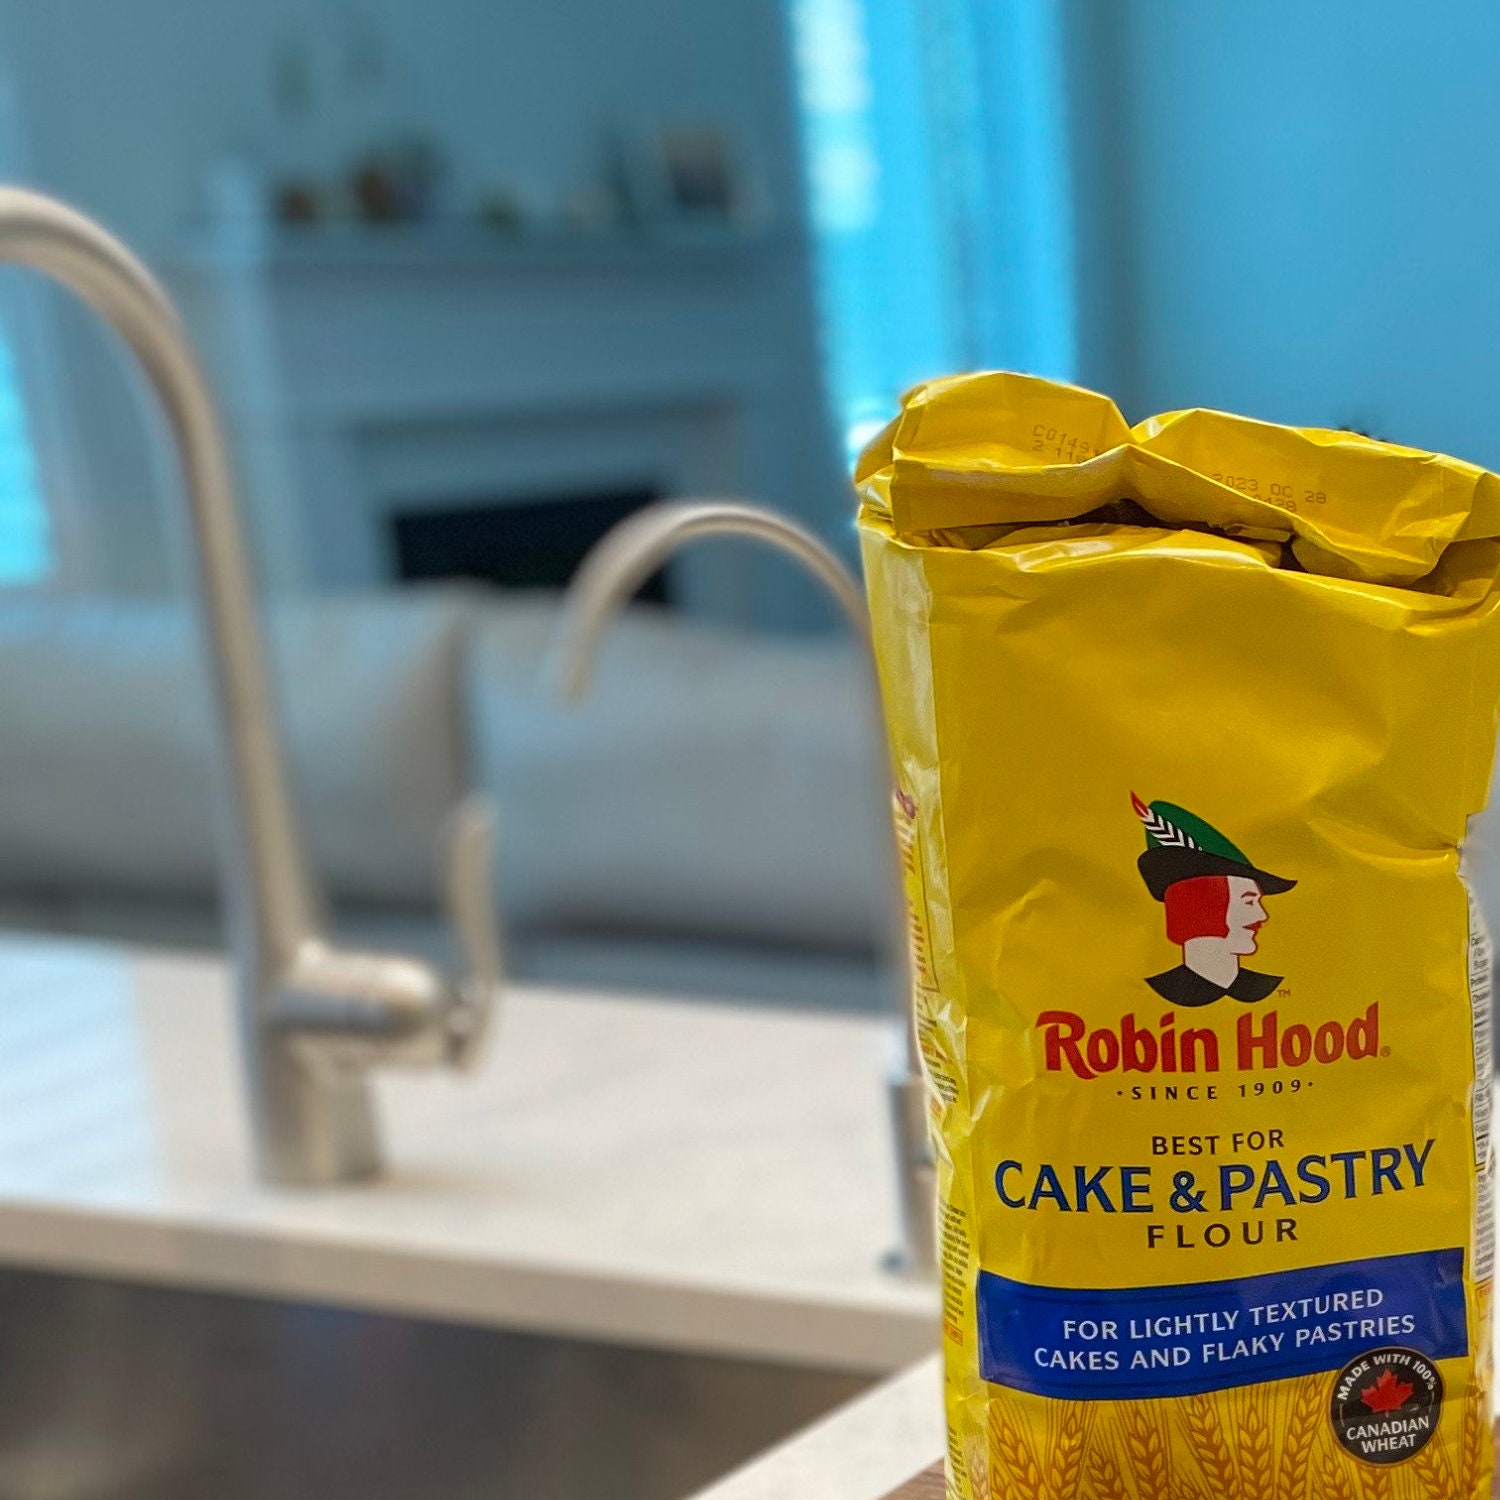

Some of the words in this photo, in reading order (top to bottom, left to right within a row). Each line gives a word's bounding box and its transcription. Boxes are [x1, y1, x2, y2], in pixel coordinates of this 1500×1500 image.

[1035, 1009, 1219, 1080] Robin
[1237, 1001, 1379, 1072] Hood
[1132, 1086, 1218, 1100] SINCE
[1238, 1079, 1302, 1098] 1909
[1151, 1135, 1220, 1156] BEST
[1232, 1129, 1285, 1153] FOR
[994, 1159, 1153, 1213] CAKE
[1169, 1170, 1209, 1213] &
[1219, 1138, 1436, 1211] PASTRY
[1147, 1218, 1299, 1249] FLOUR
[1063, 1319, 1118, 1341] FOR
[1130, 1309, 1240, 1339] LIGHTLY
[1249, 1288, 1384, 1324] TEXTURED
[1034, 1347, 1120, 1371] CAKES
[1130, 1346, 1191, 1369] AND
[1202, 1332, 1284, 1364] FLAKY
[1295, 1315, 1415, 1347] PASTRIES
[1337, 1360, 1371, 1401] MADE
[1372, 1353, 1412, 1366] WITH
[1412, 1361, 1437, 1391] 100%
[1346, 1415, 1430, 1441] CANADIAN
[1361, 1434, 1417, 1454] WHEAT
